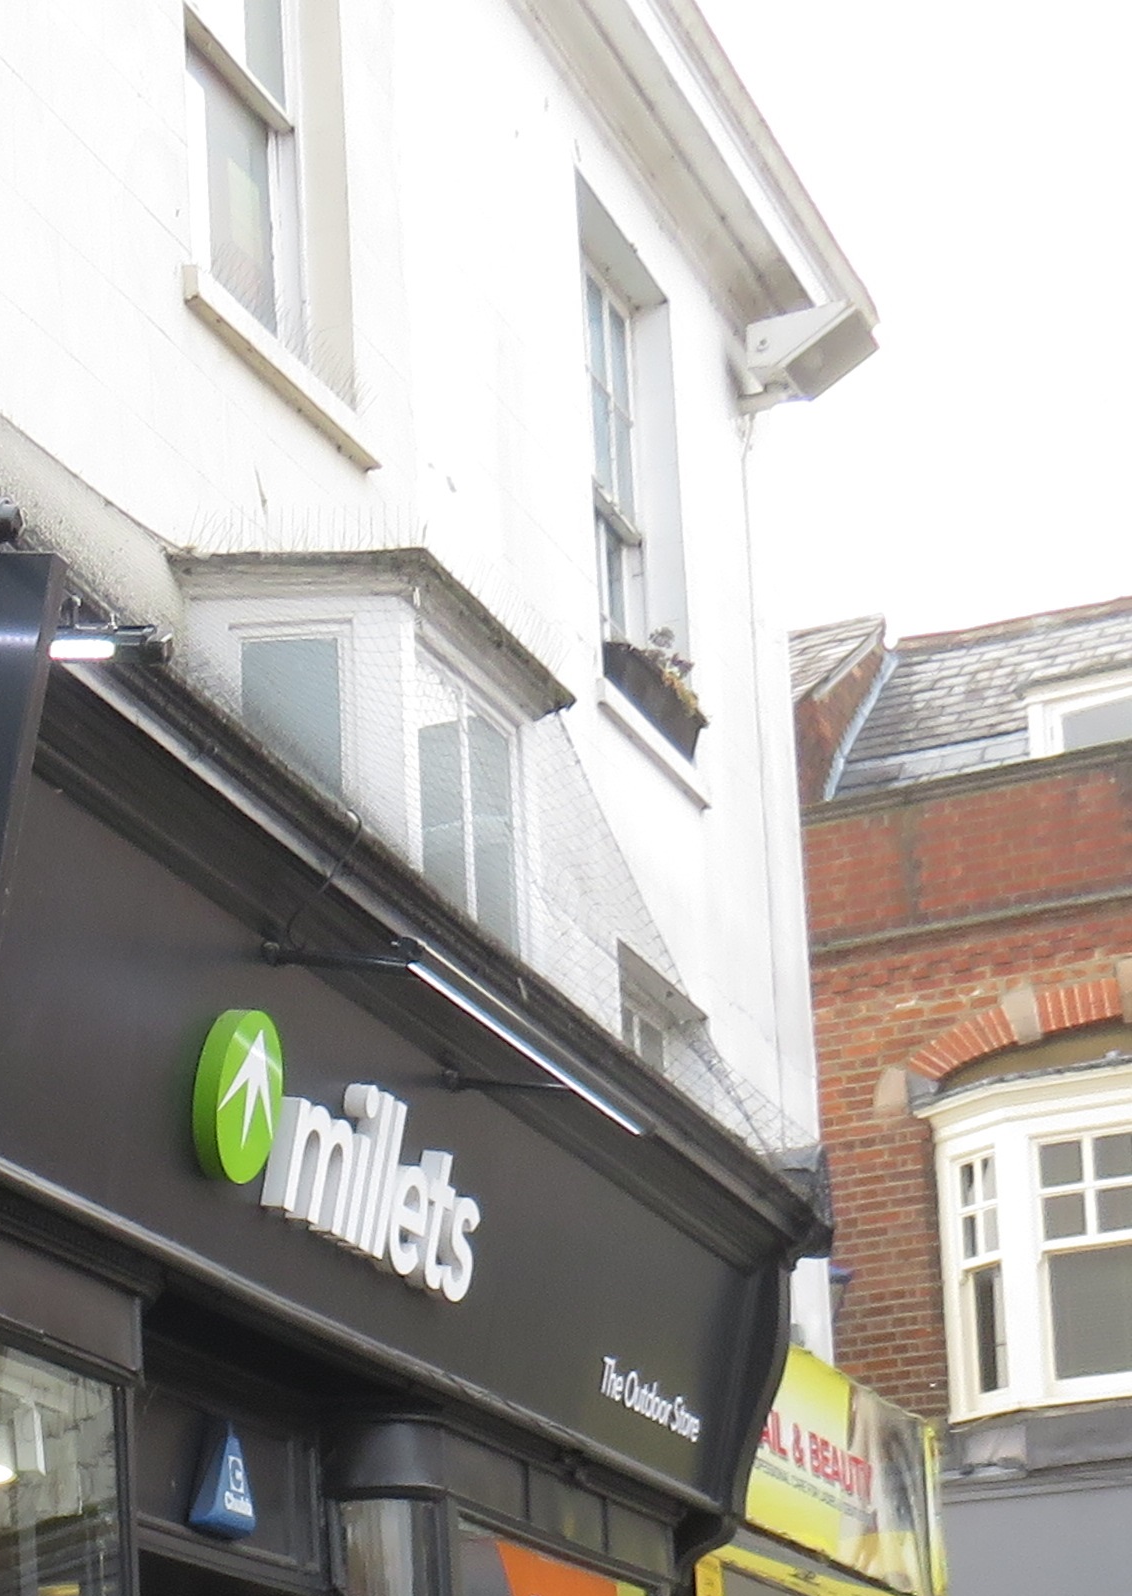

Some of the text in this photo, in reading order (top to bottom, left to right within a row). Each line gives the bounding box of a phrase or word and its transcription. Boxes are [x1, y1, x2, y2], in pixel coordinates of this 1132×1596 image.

[261, 1083, 480, 1302] millets
[602, 1355, 700, 1443] The Outdoor Store
